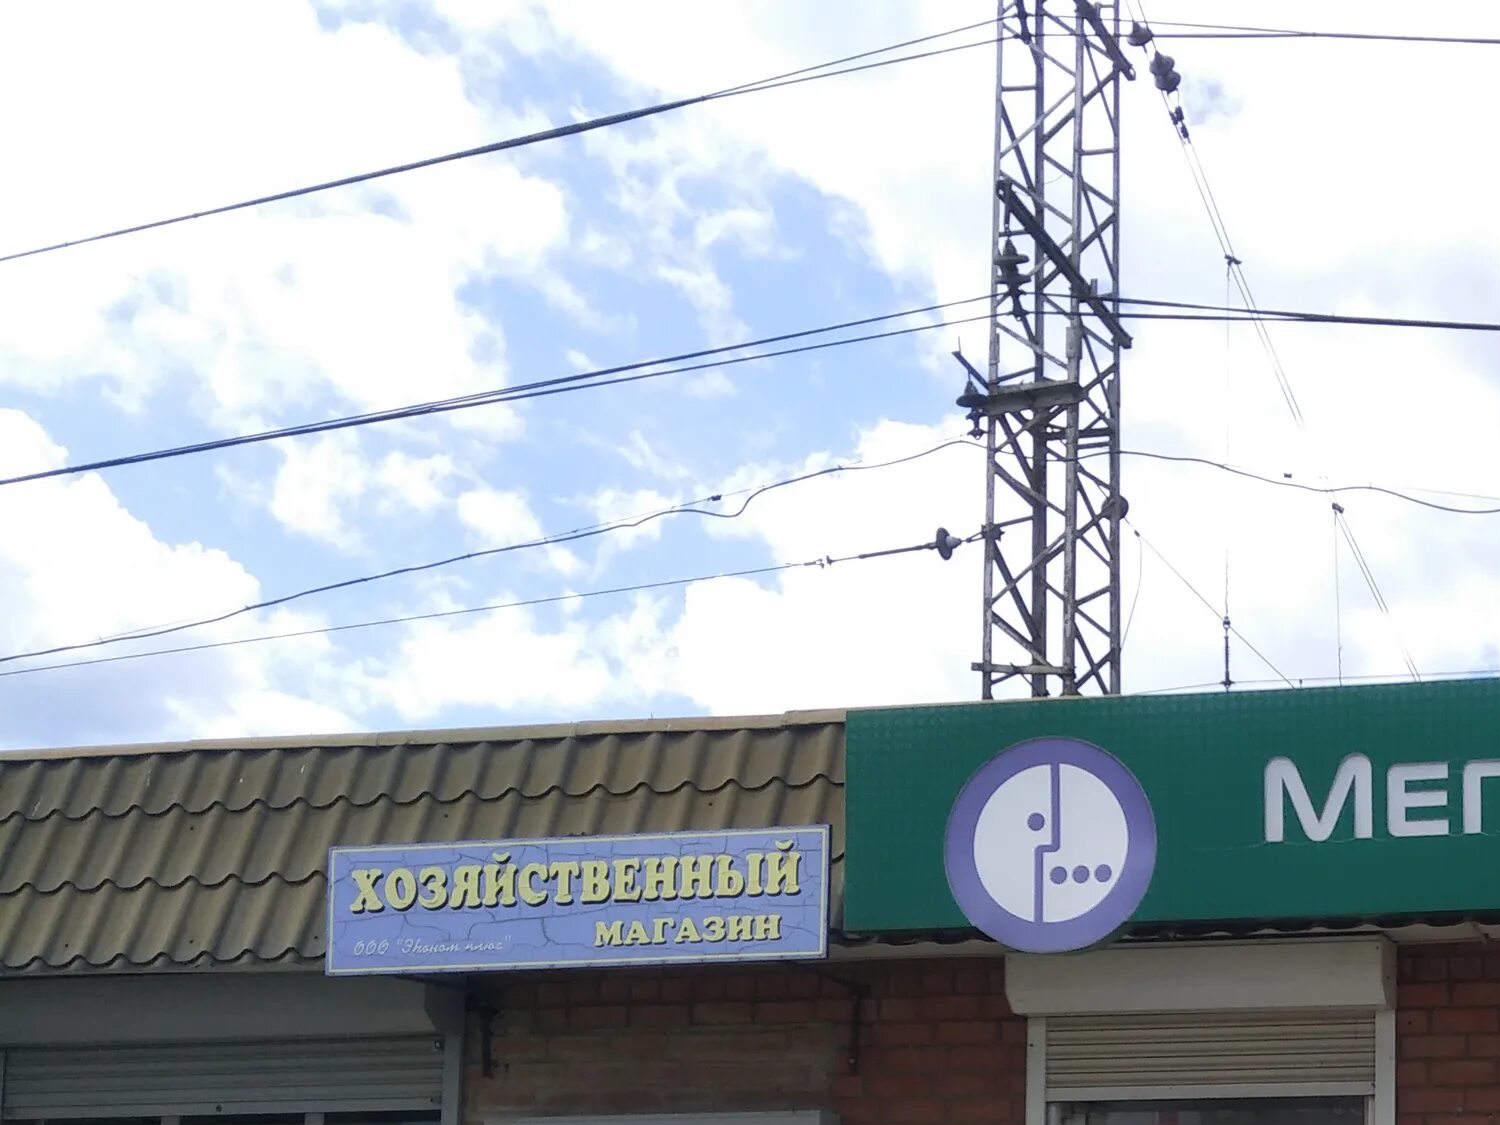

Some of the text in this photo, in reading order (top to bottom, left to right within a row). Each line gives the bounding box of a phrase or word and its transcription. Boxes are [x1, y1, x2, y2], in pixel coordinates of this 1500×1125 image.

[350, 838, 802, 915] ХОЗЯЙСТВЕННЫЙ
[353, 938, 391, 956] ООО
[594, 913, 783, 948] МАГАЗИН
